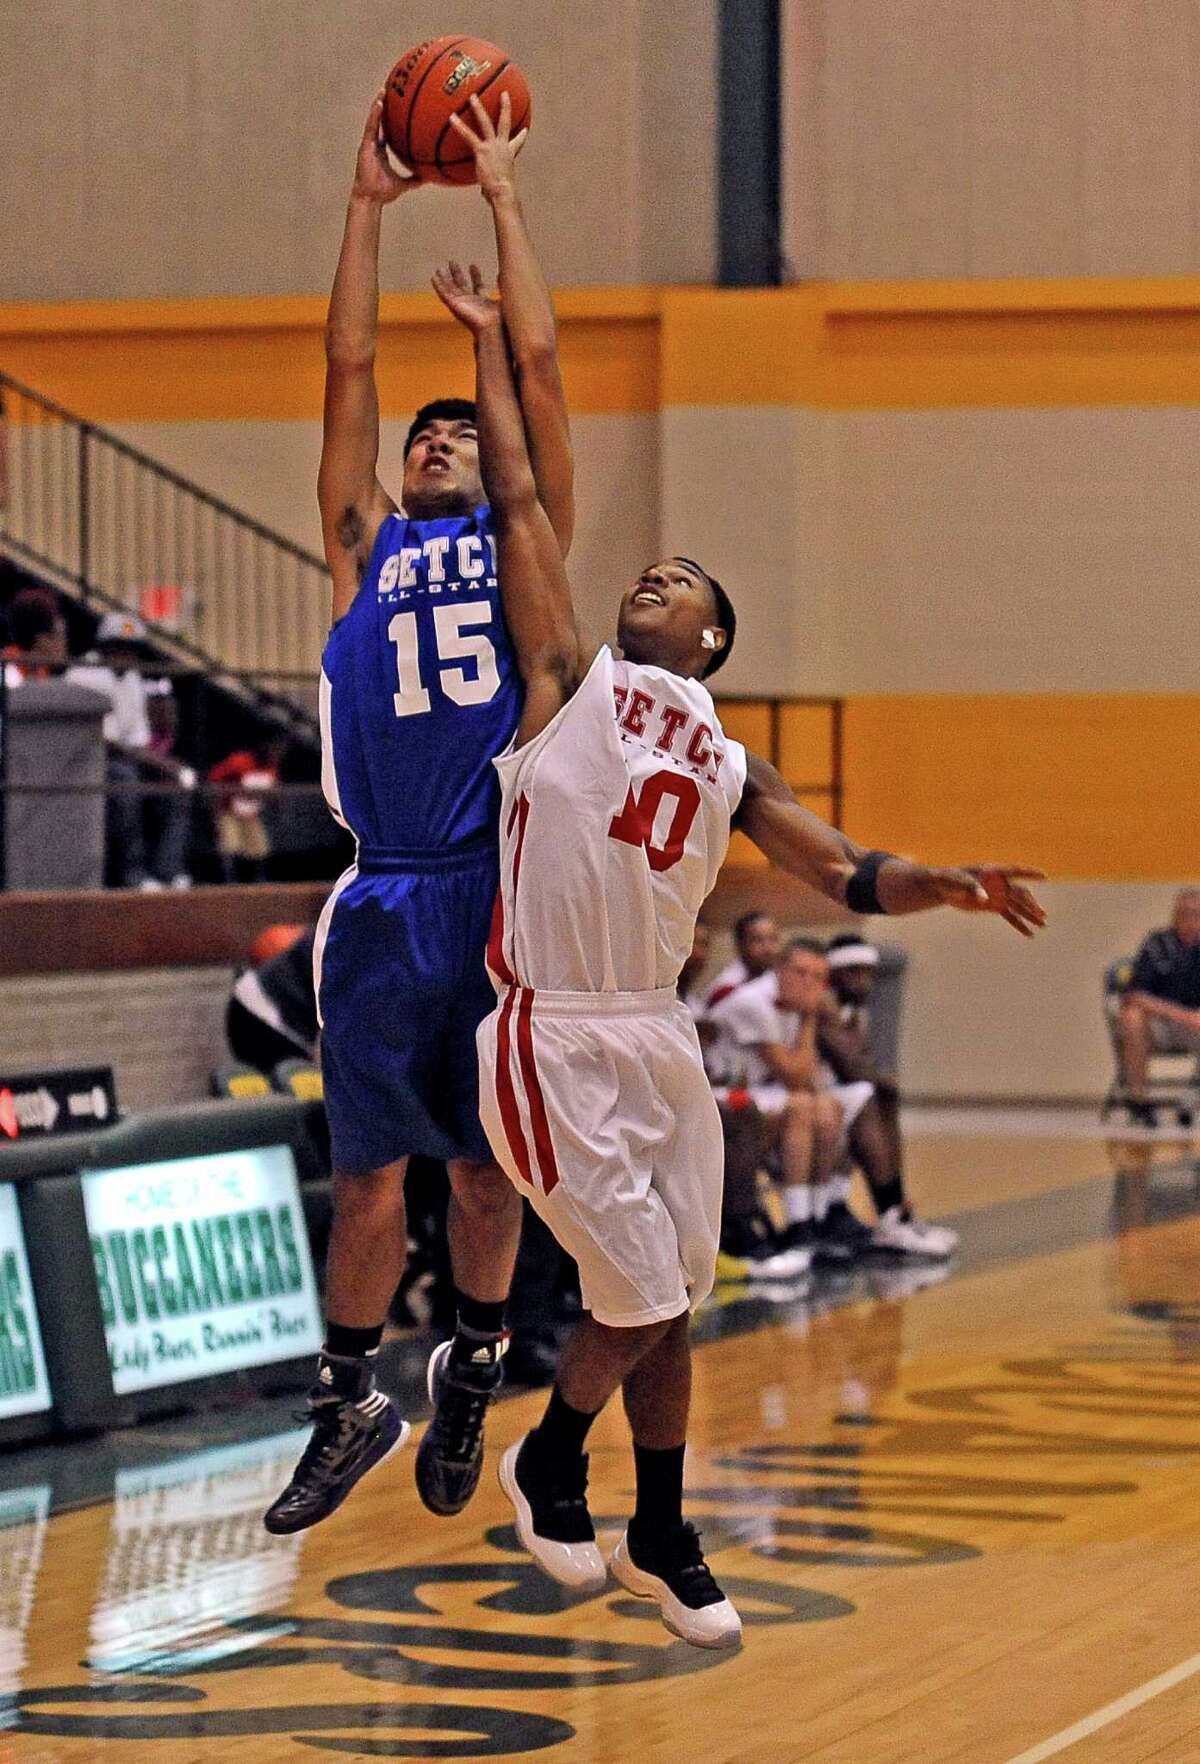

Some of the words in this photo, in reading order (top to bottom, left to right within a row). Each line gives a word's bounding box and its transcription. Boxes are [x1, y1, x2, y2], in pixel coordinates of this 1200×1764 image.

[378, 535, 497, 592] SETC
[388, 600, 501, 717] 15
[613, 687, 725, 772] SETC
